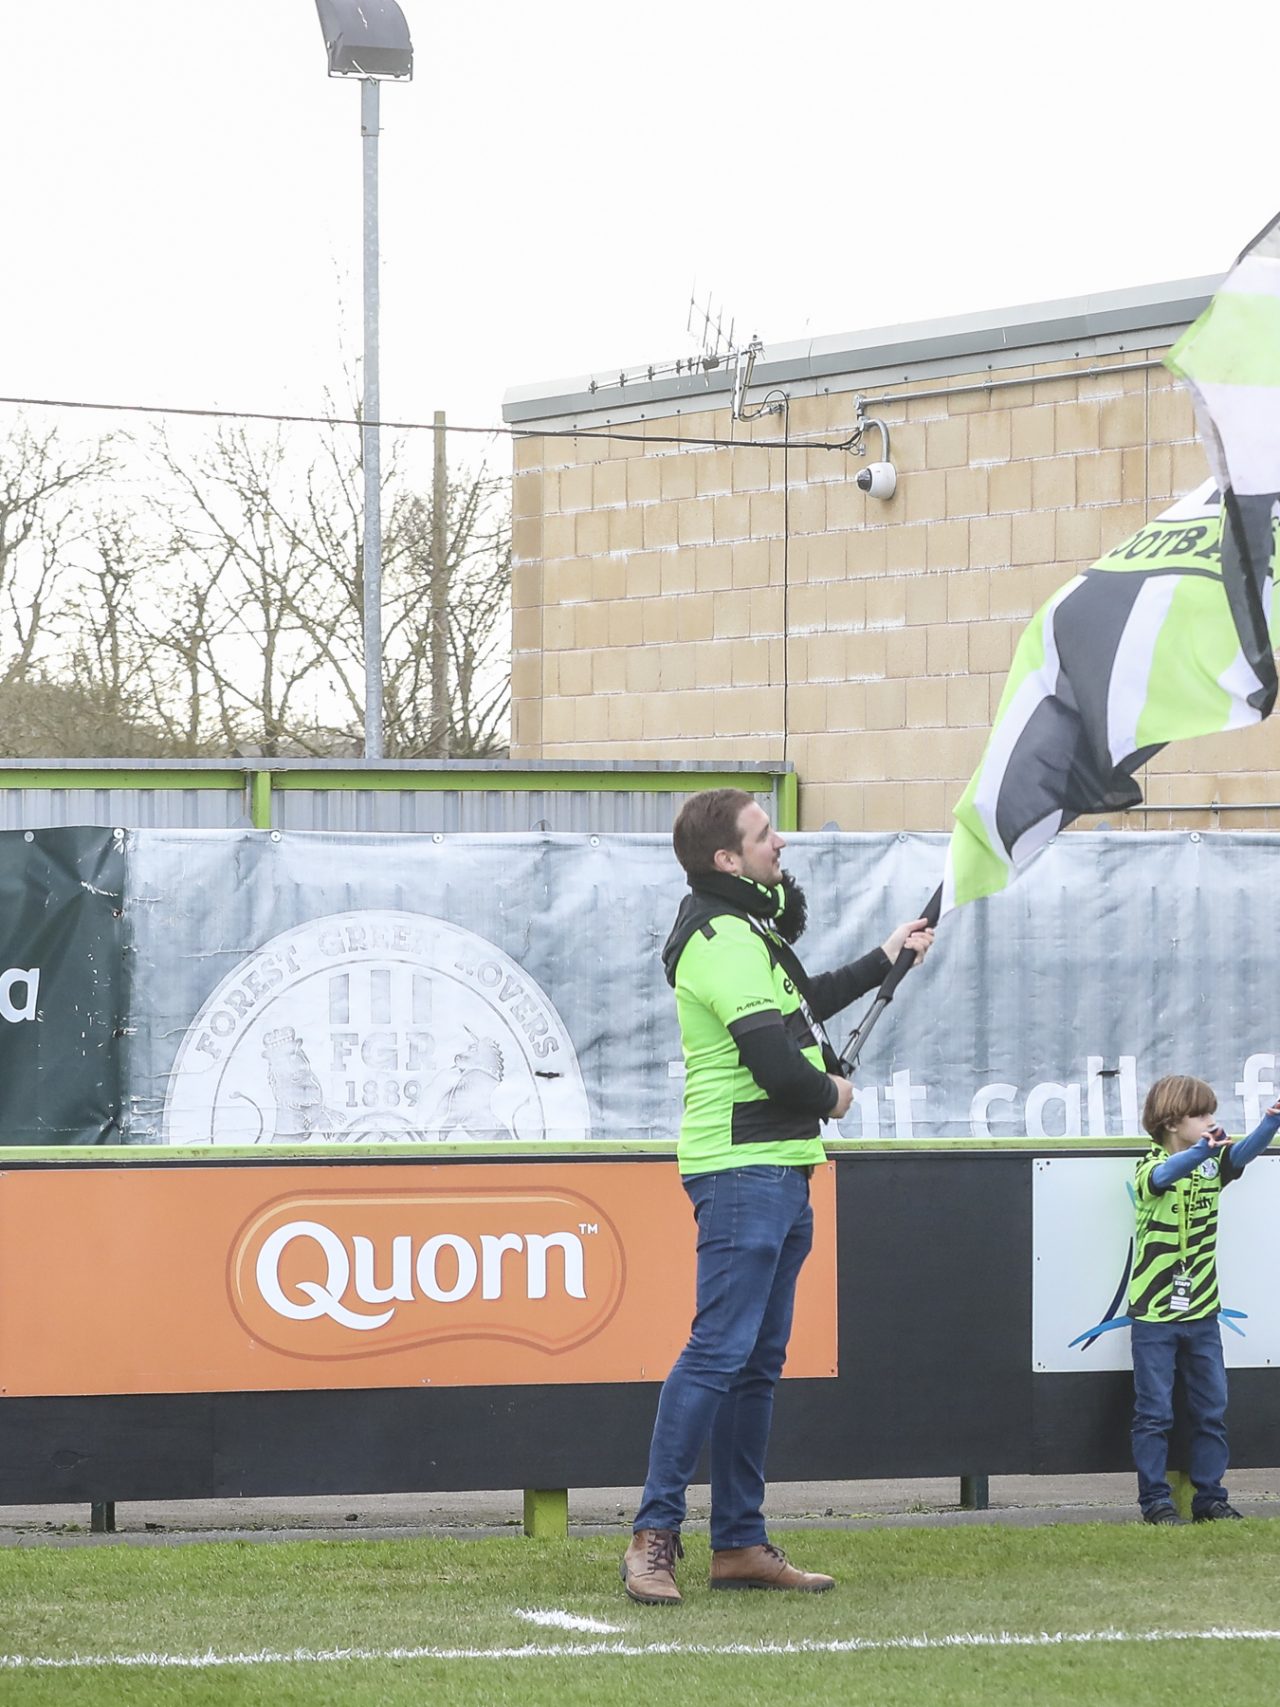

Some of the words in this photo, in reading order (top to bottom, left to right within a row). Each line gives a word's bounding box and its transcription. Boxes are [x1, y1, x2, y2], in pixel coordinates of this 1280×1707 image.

[196, 945, 302, 1061] FOREST
[318, 926, 440, 957] GREEN
[330, 1032, 437, 1072] FGR
[345, 1080, 423, 1109] 1889
[969, 1055, 1141, 1138] call
[255, 1219, 588, 1331] Quorn
